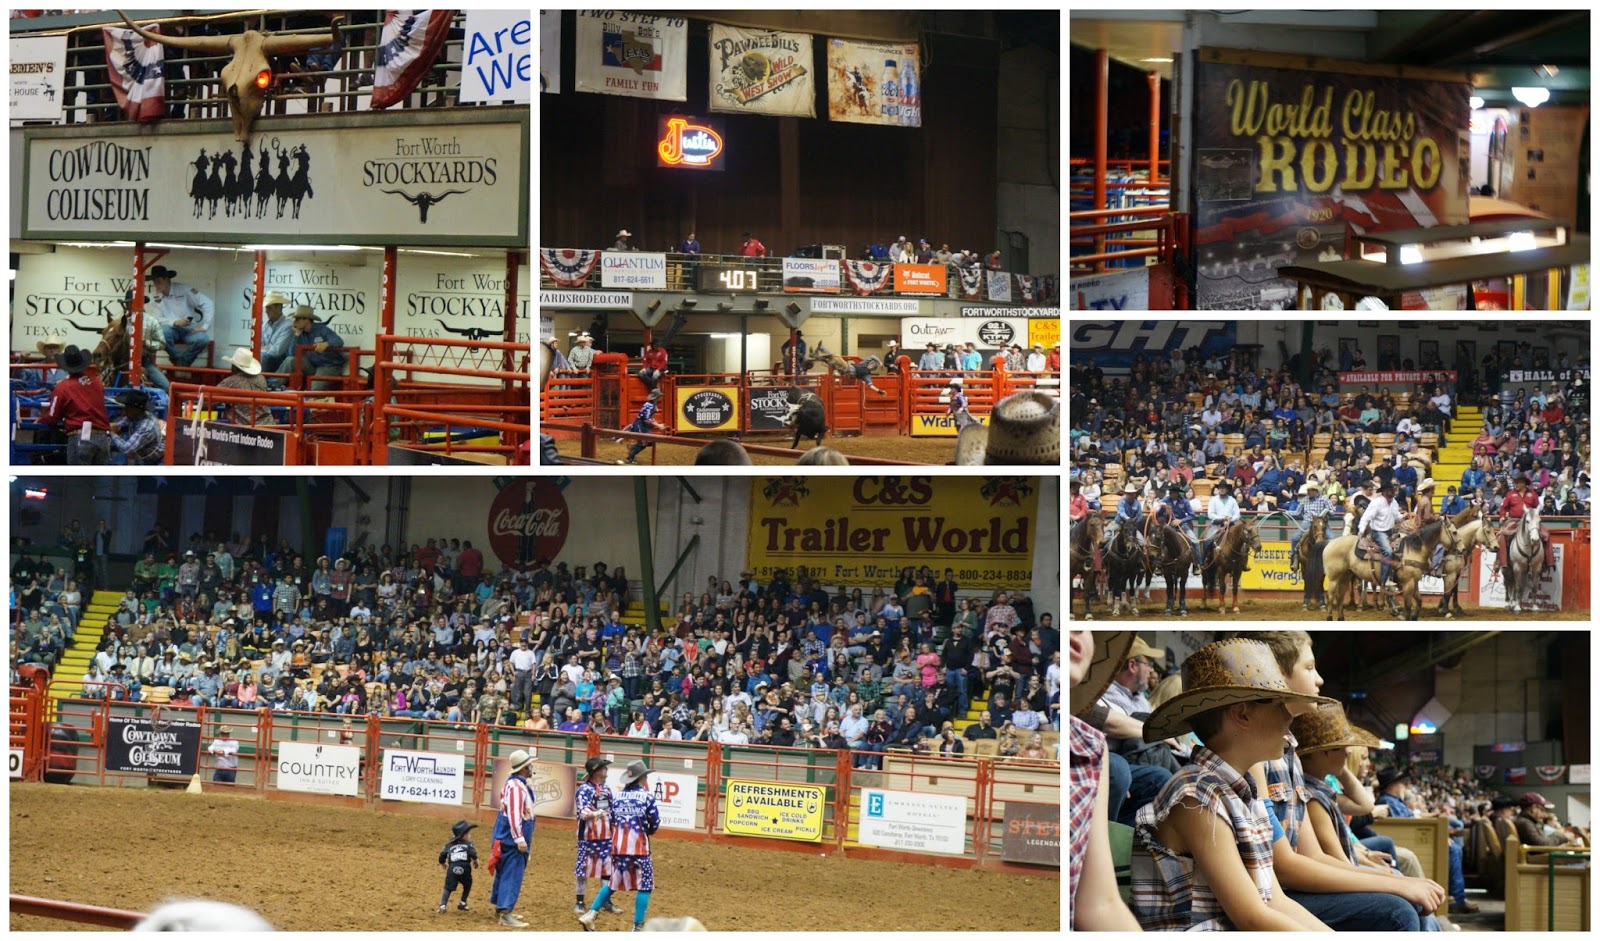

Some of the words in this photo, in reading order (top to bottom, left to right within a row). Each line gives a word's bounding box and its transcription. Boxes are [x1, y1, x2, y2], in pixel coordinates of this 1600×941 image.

[620, 11, 660, 25] STEP
[666, 16, 685, 28] TO
[771, 55, 794, 73] WILD
[14, 88, 39, 96] HOUSE
[605, 77, 639, 90] FAMILY
[642, 81, 659, 92] FUN
[742, 82, 765, 100] WEST
[766, 69, 792, 89] SHOW
[1226, 79, 1333, 138] World
[1341, 89, 1415, 143] Class
[396, 138, 420, 155] Fort
[422, 138, 461, 156] Worth
[49, 140, 151, 184] COWTOWN
[1255, 134, 1443, 194] RODEO
[364, 157, 497, 186] STOCKYARDS
[47, 188, 150, 222] COLISEUM
[1306, 207, 1333, 222] 1920
[603, 257, 664, 269] QUANTUM
[64, 276, 99, 293] Fort
[268, 269, 293, 285] Fort
[300, 269, 339, 286] Worth
[436, 273, 465, 290] Fort
[472, 274, 508, 291] Wort
[813, 301, 918, 312] FORTWORTHSTOCKYARDS.ORG
[24, 325, 67, 337] TEXAS
[332, 323, 363, 336] TEXAS
[406, 327, 440, 340] TEXAS
[1035, 322, 1058, 330] C&S
[1346, 373, 1379, 382] AVAILABLE
[1381, 373, 1393, 381] FOR
[1395, 373, 1420, 381] PRIVATE
[1524, 371, 1554, 380] HALL
[1560, 370, 1571, 379] of
[696, 412, 721, 420] RODEO
[229, 432, 240, 444] First
[240, 433, 257, 446] Indoor
[257, 435, 274, 449] Rodeo
[852, 476, 934, 505] C&S
[493, 508, 563, 537] Coca-Cola
[760, 517, 891, 552] Trailer
[902, 517, 1029, 553] World
[835, 565, 859, 577] Fort
[864, 565, 901, 578] Worth
[122, 724, 177, 744] COWTOWN
[128, 745, 182, 767] COLISEUM
[417, 776, 443, 785] CLEANING
[388, 785, 456, 799] 817-624-1123
[733, 784, 818, 799] REFRESHMENTS
[746, 796, 804, 808] AVAILABLE
